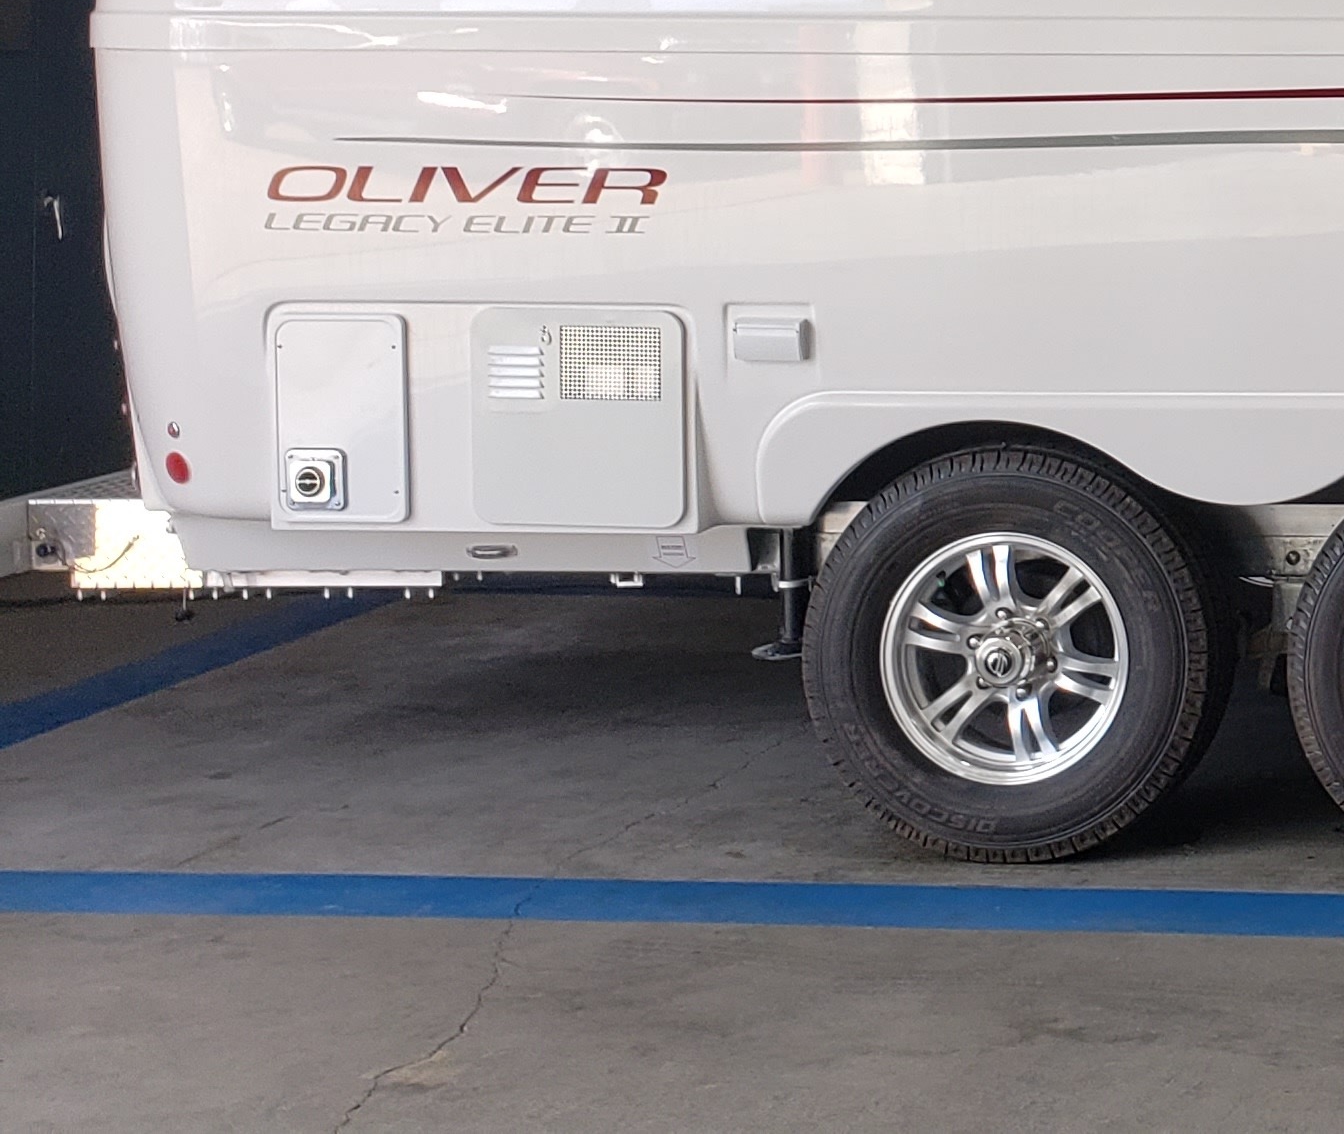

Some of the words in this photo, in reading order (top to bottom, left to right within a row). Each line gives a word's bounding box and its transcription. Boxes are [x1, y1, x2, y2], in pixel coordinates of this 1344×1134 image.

[267, 165, 669, 205] OLIVER
[264, 212, 453, 234] LEGACY
[462, 214, 596, 235] ELITE
[604, 214, 651, 235] II
[1052, 498, 1161, 613] COOPER
